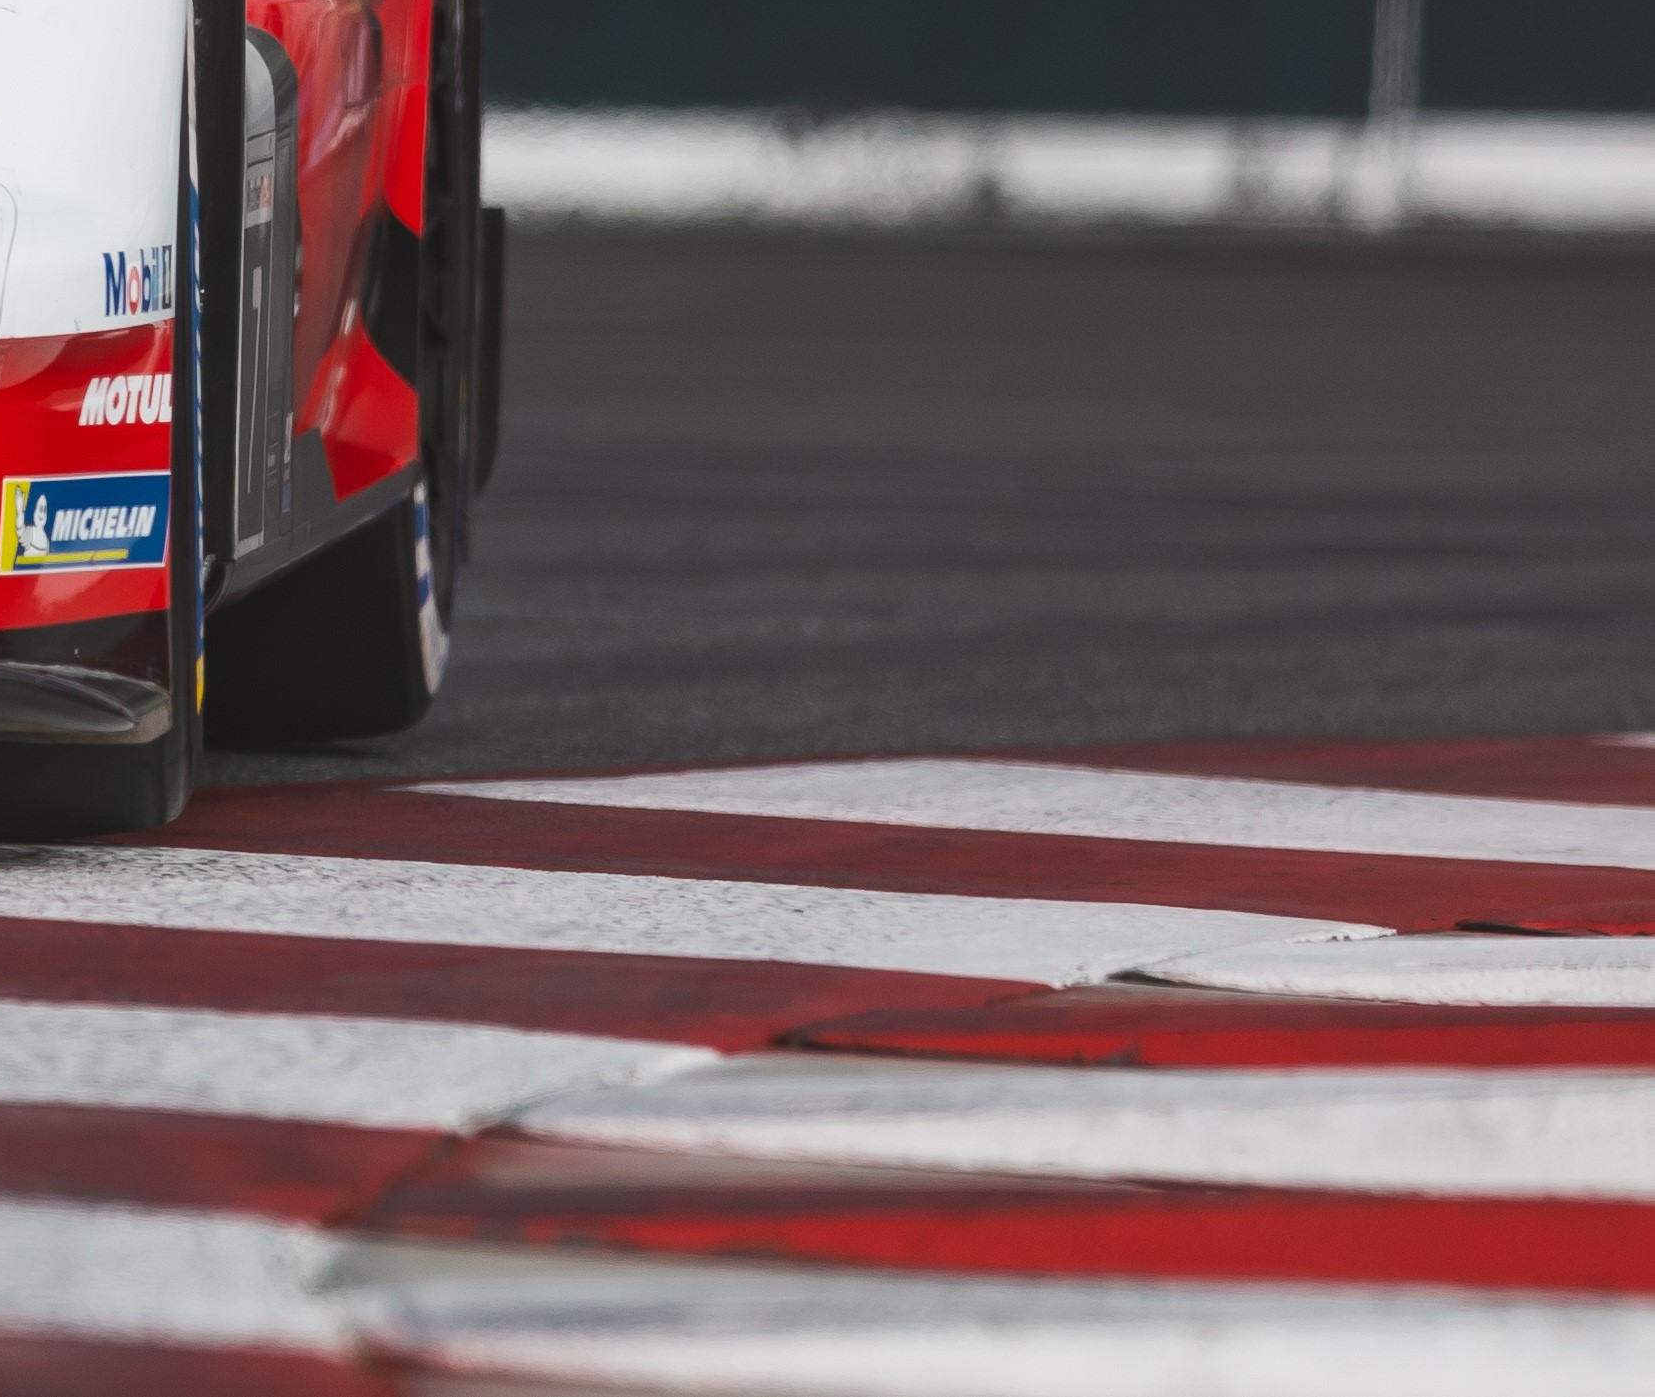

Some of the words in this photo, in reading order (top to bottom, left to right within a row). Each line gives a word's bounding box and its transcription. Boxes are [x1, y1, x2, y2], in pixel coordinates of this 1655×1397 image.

[102, 247, 160, 318] Mobil
[78, 372, 173, 427] MOTUL
[51, 504, 158, 541] MICHELIN
